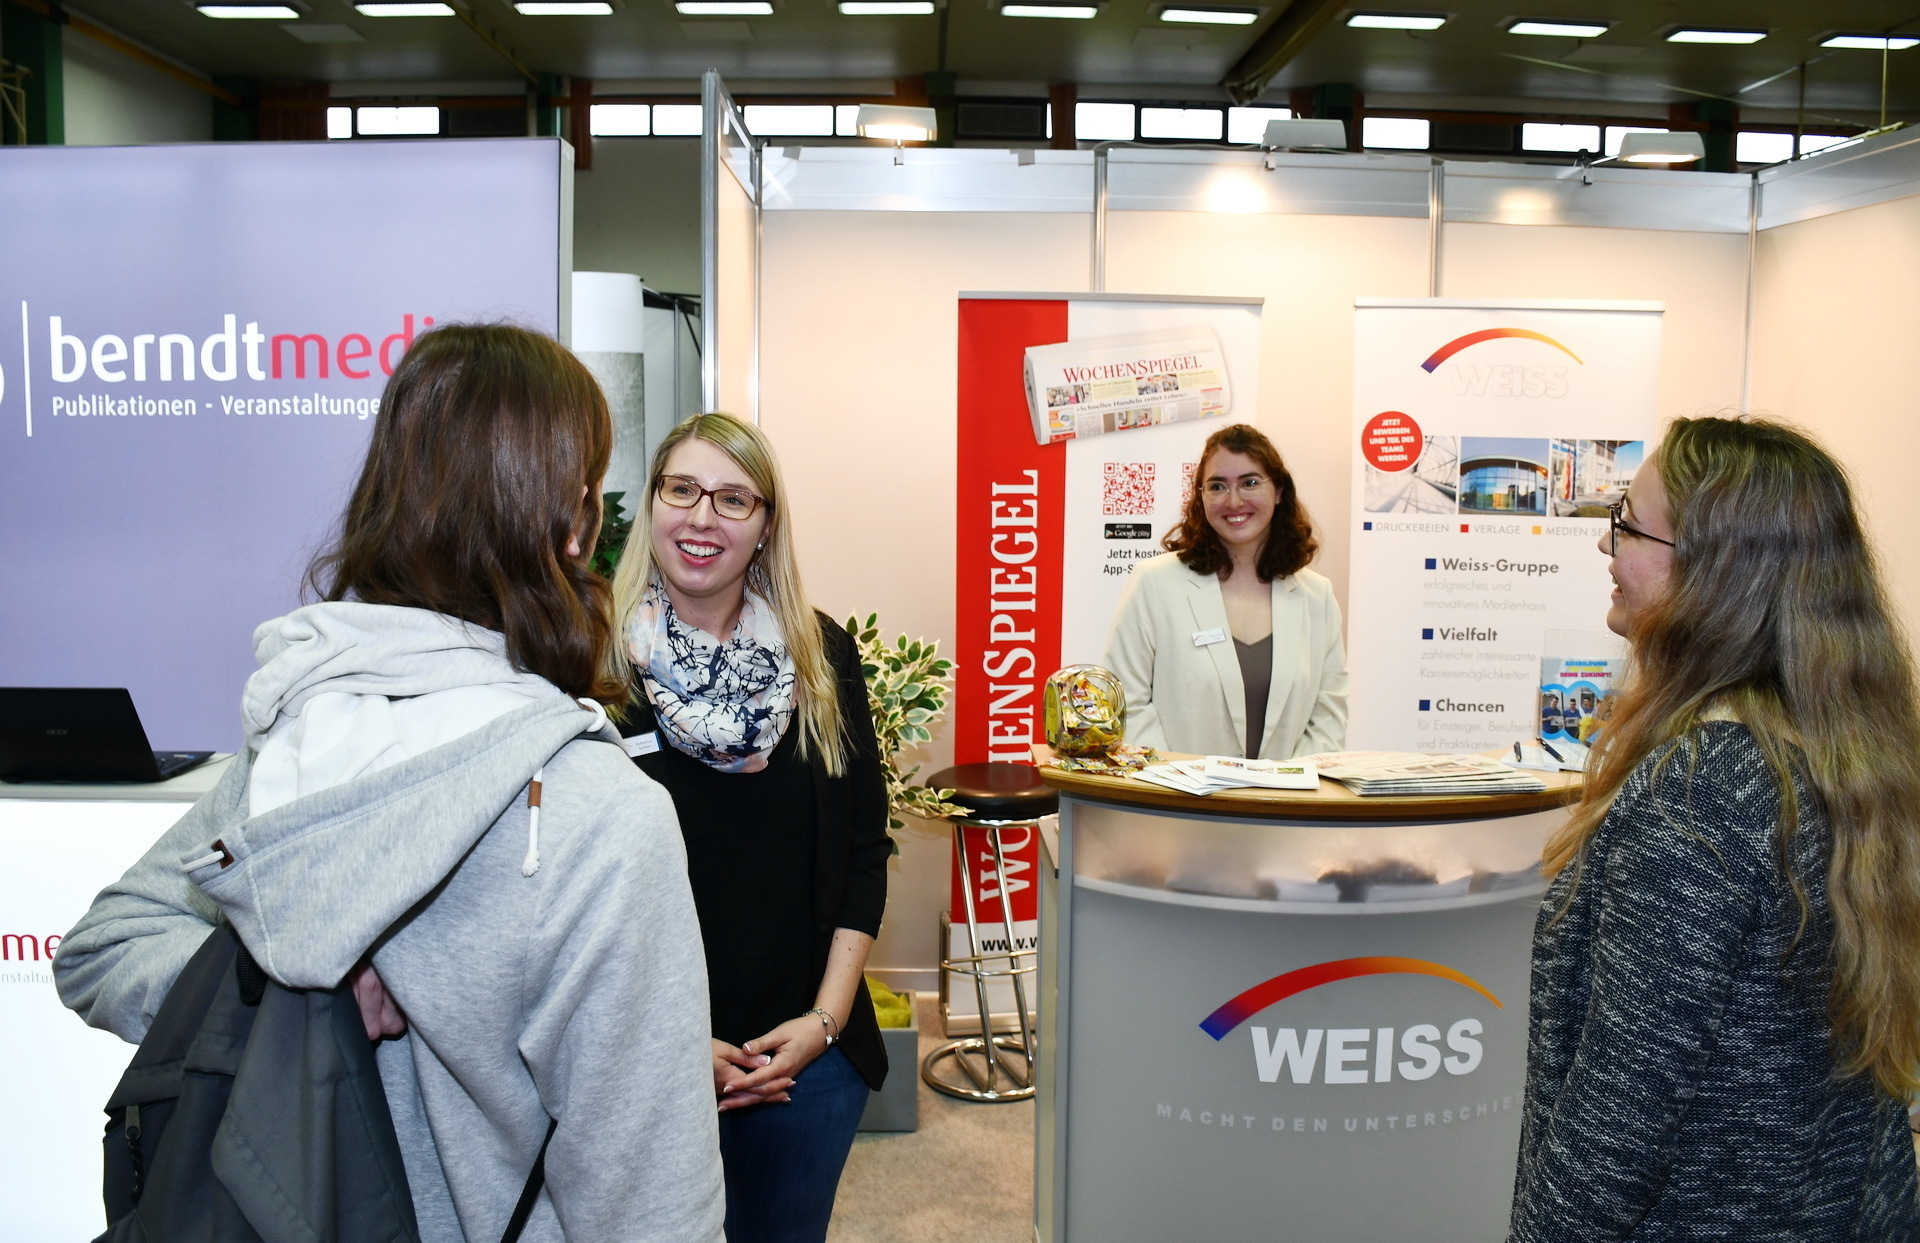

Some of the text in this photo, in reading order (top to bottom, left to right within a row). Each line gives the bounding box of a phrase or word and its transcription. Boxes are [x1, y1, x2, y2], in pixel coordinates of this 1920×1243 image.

[50, 313, 434, 383] berndtmed
[1062, 355, 1202, 383] WOCHENSPIEGEL
[1449, 363, 1569, 399] WEISS
[52, 395, 197, 417] Publikationen
[220, 393, 381, 421] Veranstaltunge
[1381, 418, 1401, 426] JETZT
[1369, 437, 1386, 445] UND
[1380, 445, 1404, 453] TEAMS
[1377, 454, 1408, 462] WERDEN
[1376, 521, 1450, 533] DRUCKEREIEN
[1473, 524, 1521, 534] VERLAGE
[1545, 526, 1588, 536] MEDIEN
[1114, 529, 1150, 539] Google play
[1107, 549, 1132, 559] Jetzt
[1442, 557, 1559, 577] Weiss-Gruppe
[1423, 580, 1512, 593] erfolgreiches und
[1423, 599, 1547, 611] innovatives Medienhaus
[1439, 627, 1498, 641] Vielfalt
[1421, 650, 1536, 662] zahlreiche interessante
[1419, 668, 1530, 681] Karrieremöglichkeiten
[1436, 698, 1505, 713] Chancen
[1417, 720, 1431, 731] für
[1416, 738, 1499, 750] und Praktikanten
[1250, 1018, 1484, 1084] WEISS
[1156, 1102, 1256, 1130] MACHT
[1272, 1117, 1328, 1133] DEN
